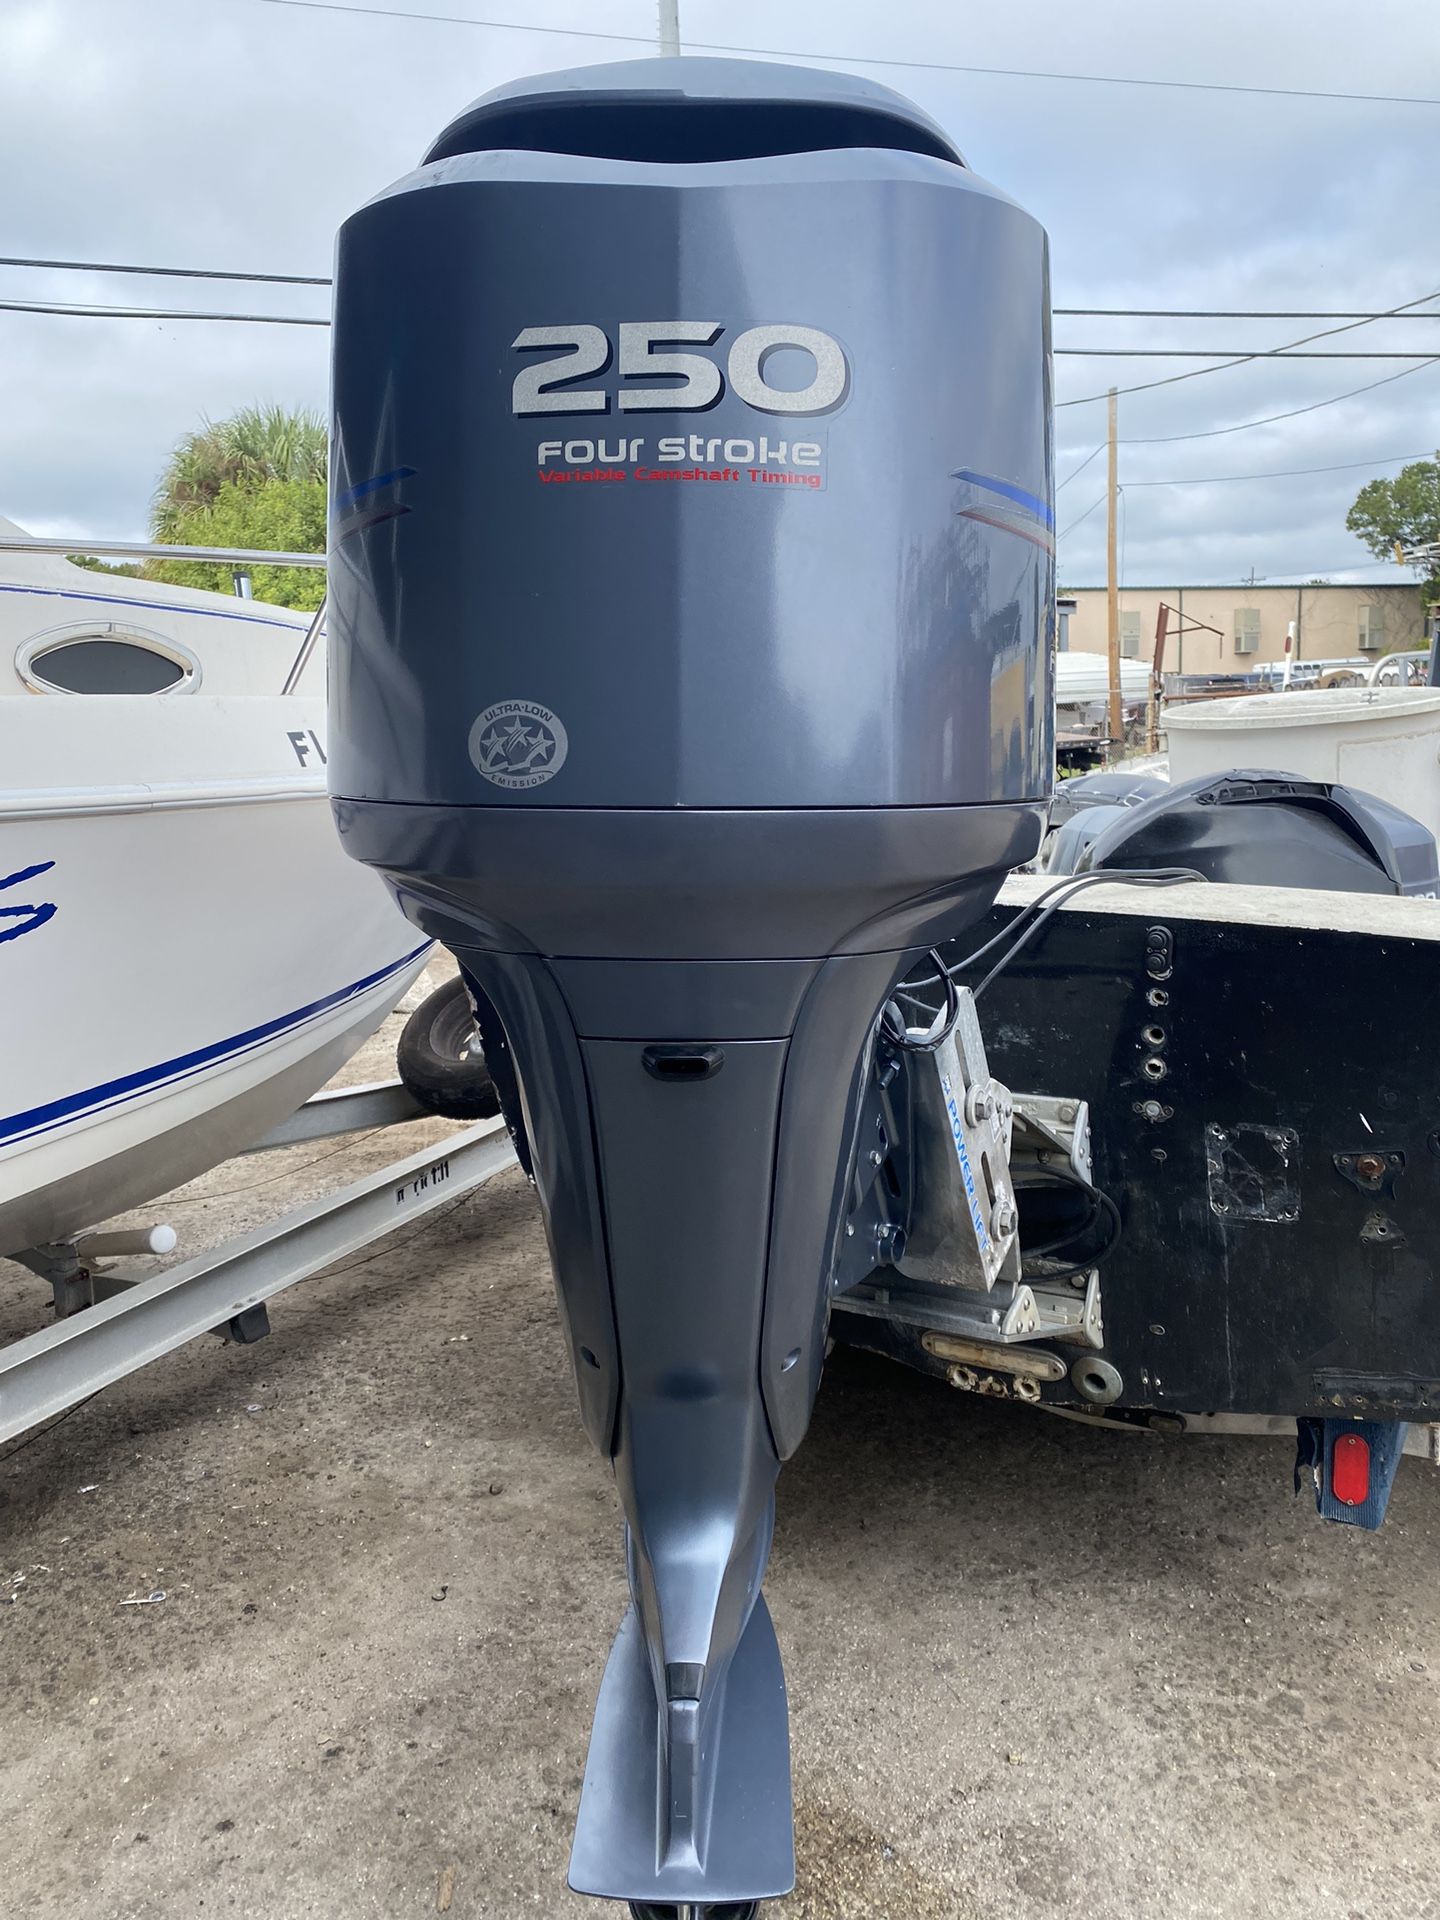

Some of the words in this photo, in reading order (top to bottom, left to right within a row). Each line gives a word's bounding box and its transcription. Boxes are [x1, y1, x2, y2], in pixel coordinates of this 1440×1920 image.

[510, 321, 851, 419] 250
[538, 467, 627, 485] Variable
[634, 466, 740, 482] Camshaft
[746, 468, 823, 488] Timing
[491, 774, 545, 788] EMISSION
[948, 1099, 975, 1196] POWER
[971, 1199, 988, 1249] LIFT
